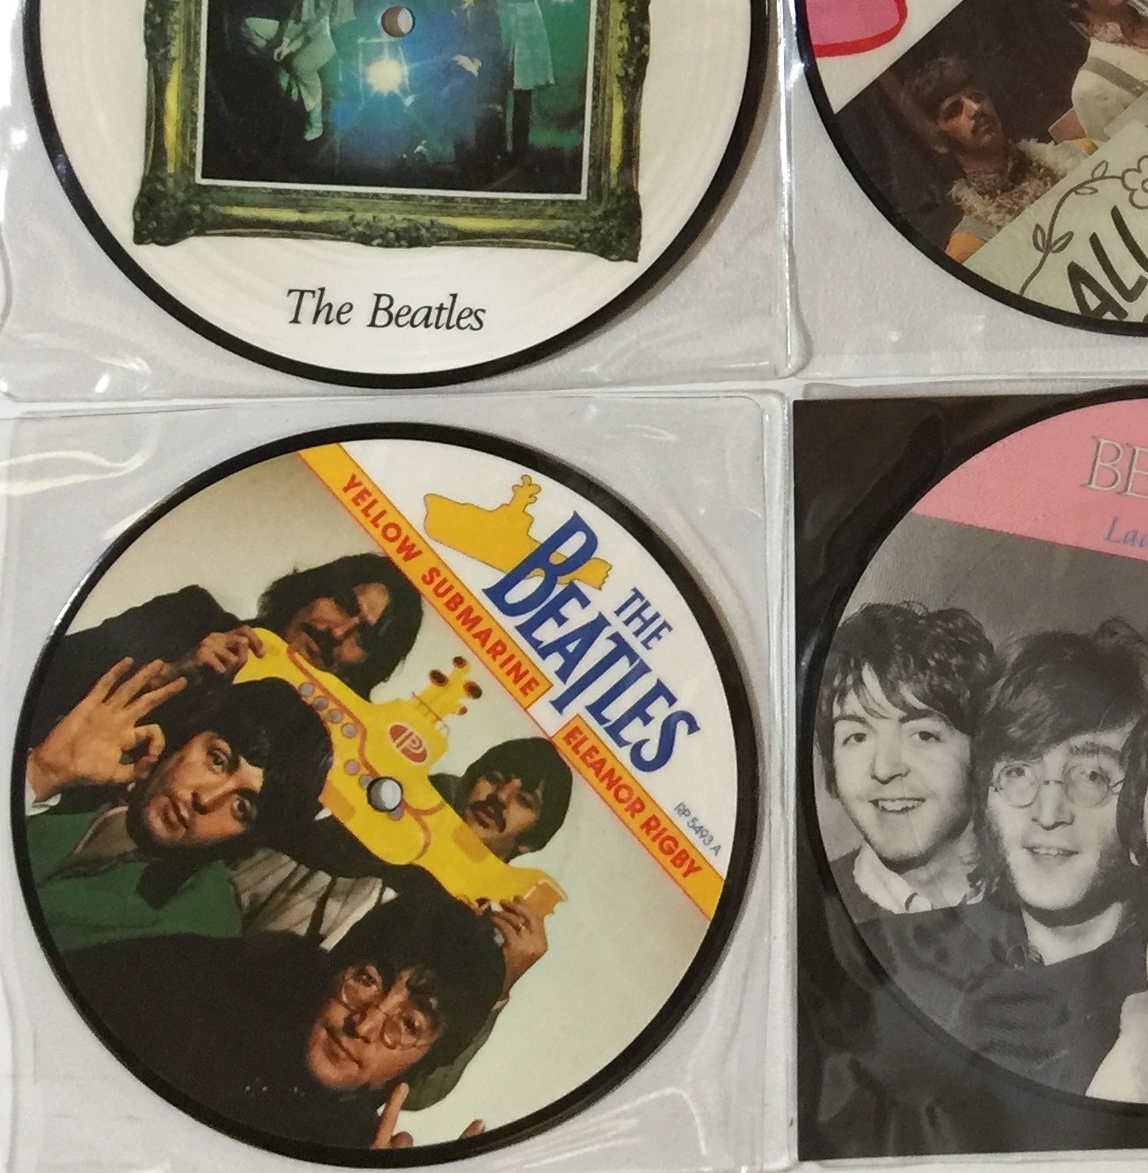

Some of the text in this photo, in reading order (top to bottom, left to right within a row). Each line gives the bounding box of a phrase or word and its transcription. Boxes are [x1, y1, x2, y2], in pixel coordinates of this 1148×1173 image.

[287, 286, 486, 331] The Beatles
[341, 474, 540, 696] YELLOW SUBMARINE
[614, 587, 673, 651] THE
[482, 510, 701, 773] BEATLES
[563, 726, 703, 879] ELEANOR RIGBY
[674, 802, 721, 857] RP 5493 A
